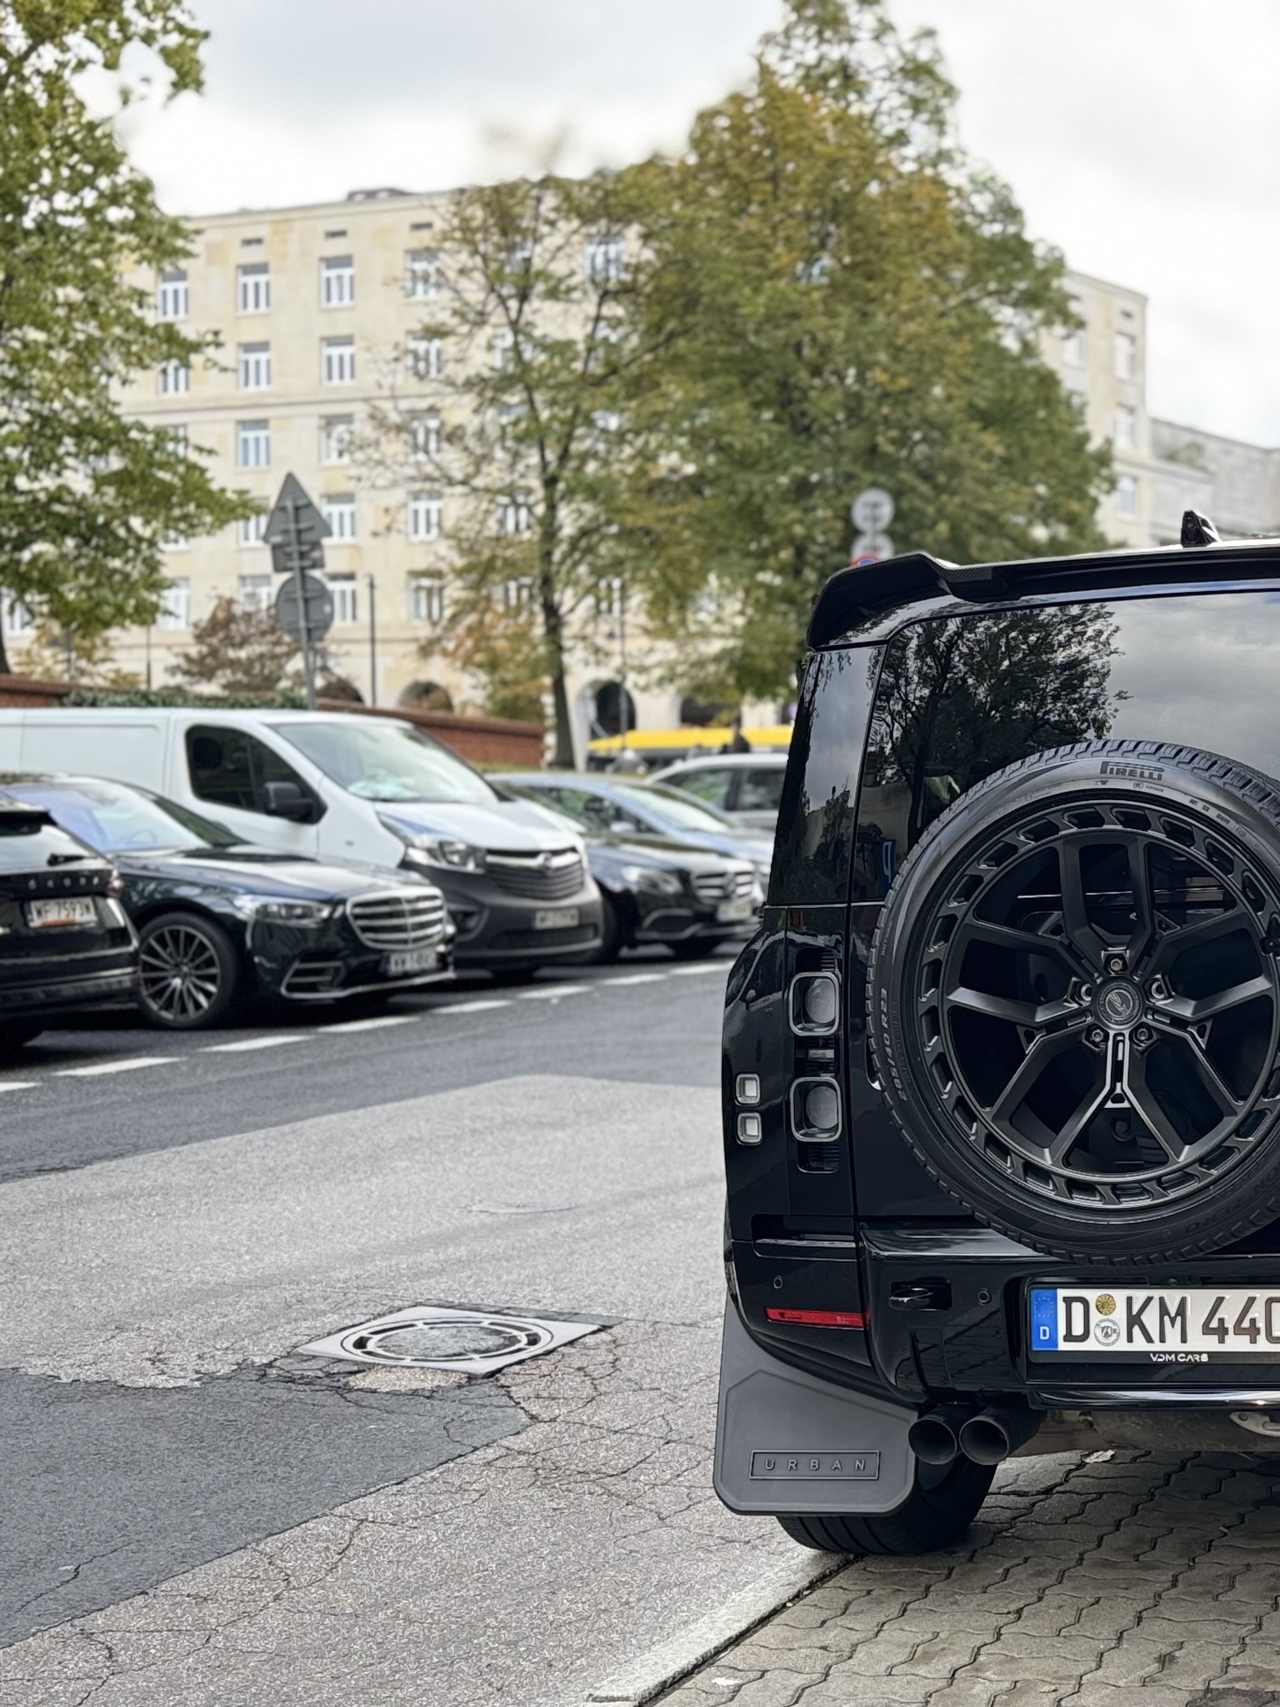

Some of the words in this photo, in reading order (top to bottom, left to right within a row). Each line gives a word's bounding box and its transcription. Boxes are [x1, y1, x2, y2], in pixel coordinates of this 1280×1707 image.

[1100, 760, 1165, 781] PIRELLI
[1062, 1296, 1091, 1343] D
[1126, 1296, 1189, 1344] KM
[1039, 1327, 1050, 1340] D
[764, 1459, 866, 1471] URBAN
